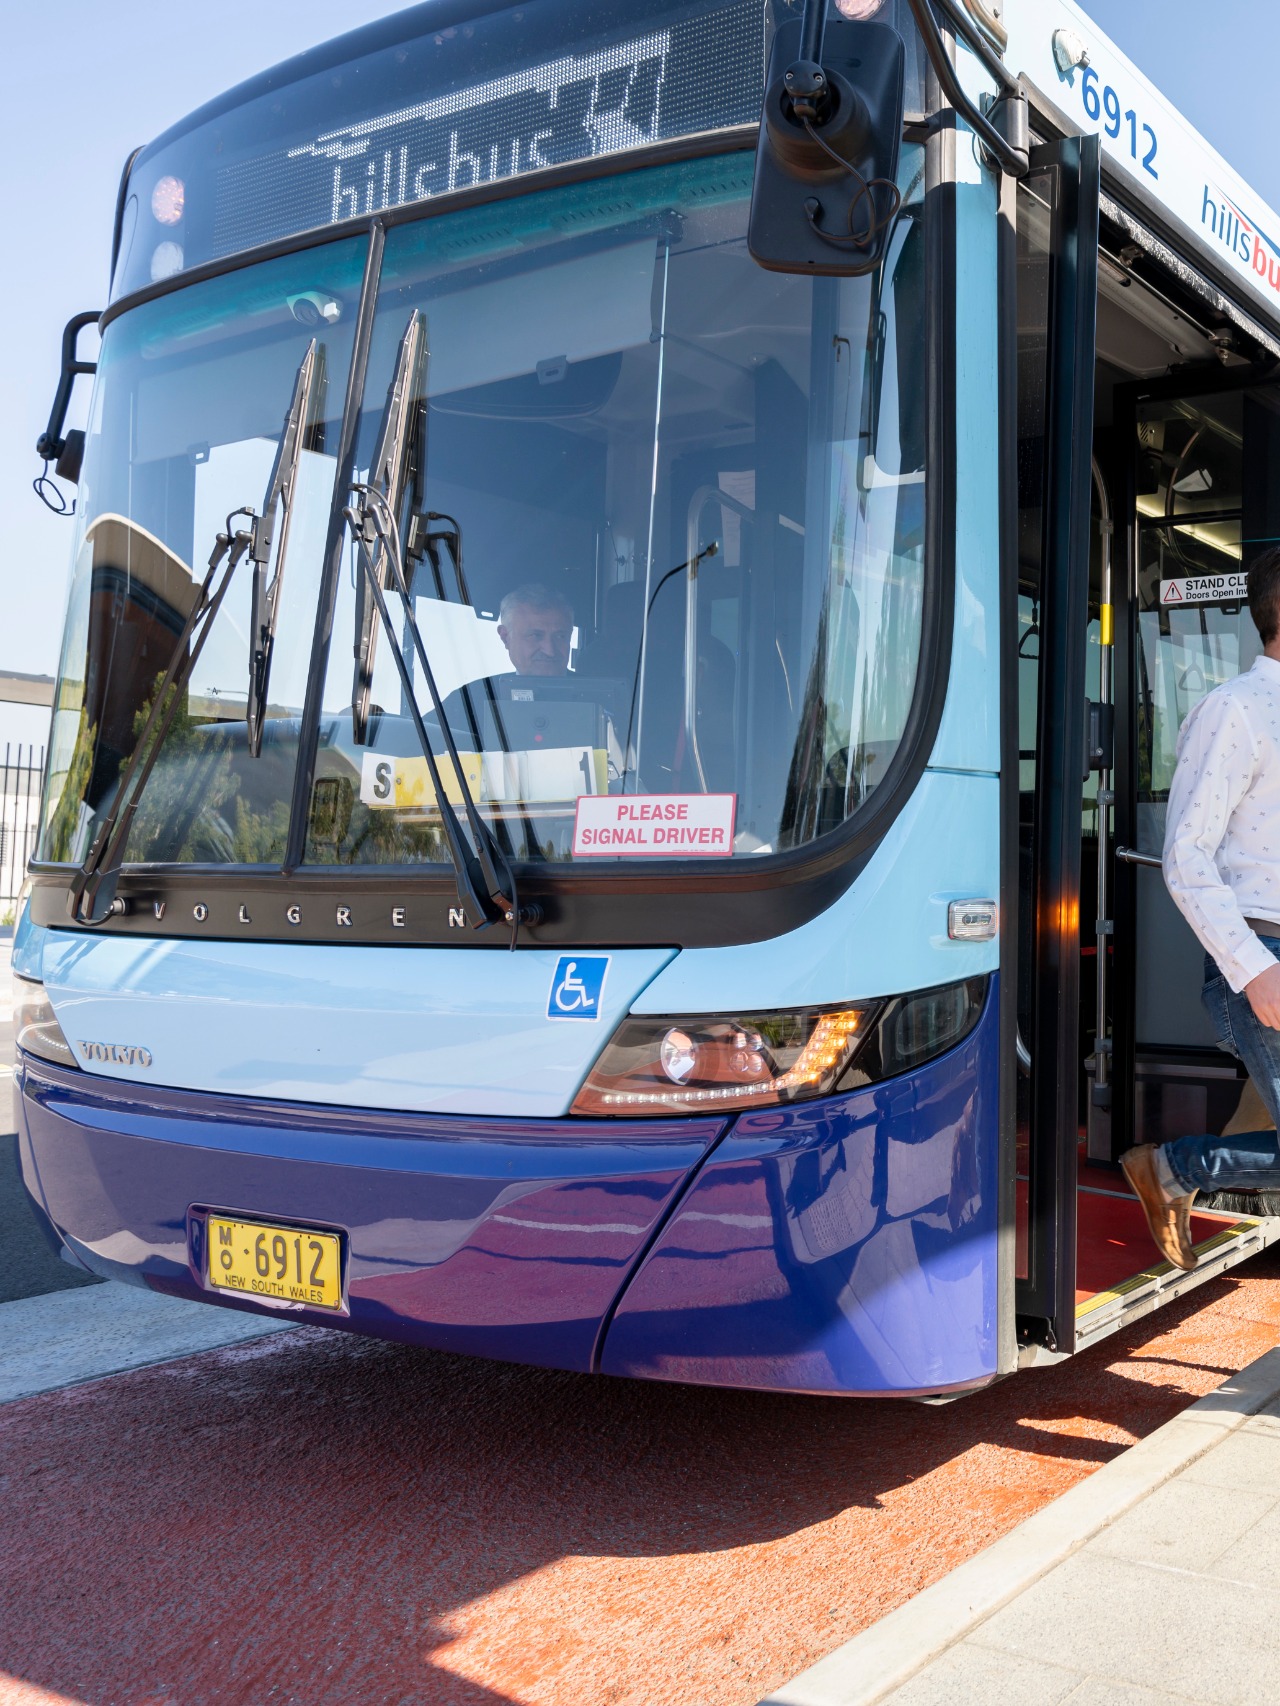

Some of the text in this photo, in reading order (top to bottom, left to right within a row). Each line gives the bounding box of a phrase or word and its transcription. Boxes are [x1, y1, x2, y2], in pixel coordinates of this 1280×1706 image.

[1082, 66, 1159, 181] 6912
[1186, 578, 1225, 590] STAND
[1212, 589, 1234, 599] Open
[373, 751, 592, 799] S 1
[617, 804, 688, 820] PLEASE
[581, 827, 724, 845] SIGNAL DRIVER
[152, 902, 466, 928] VOLGREN
[77, 1040, 152, 1067] VOLVO
[255, 1232, 325, 1287] 6912
[224, 1274, 323, 1303] NEW SOUTH WALES
